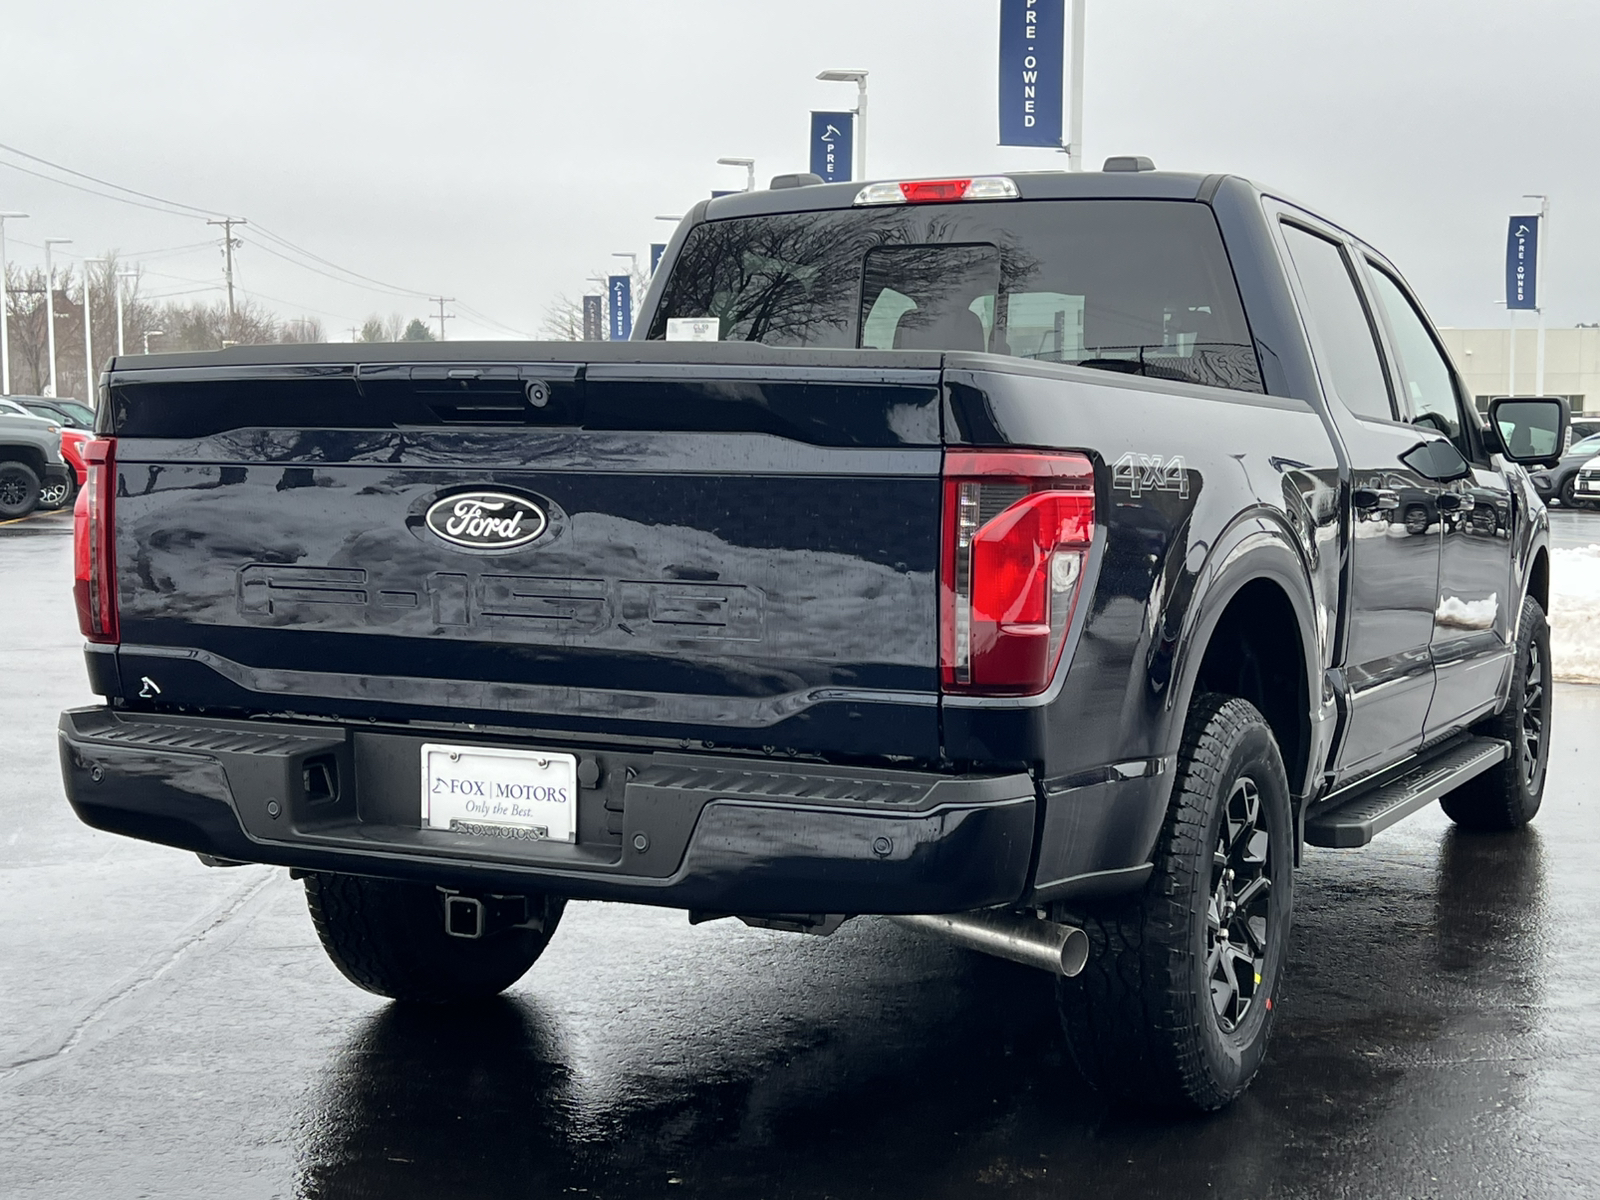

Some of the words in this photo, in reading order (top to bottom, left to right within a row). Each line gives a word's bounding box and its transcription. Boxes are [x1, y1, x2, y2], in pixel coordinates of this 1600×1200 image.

[1516, 238, 1525, 301] PRE-OWNED
[446, 499, 523, 538] Ford
[235, 562, 767, 643] F-150
[450, 779, 485, 796] FOX
[496, 783, 567, 803] MOTORS
[465, 800, 490, 818] Only
[492, 803, 509, 815] the
[511, 804, 533, 818] Best.
